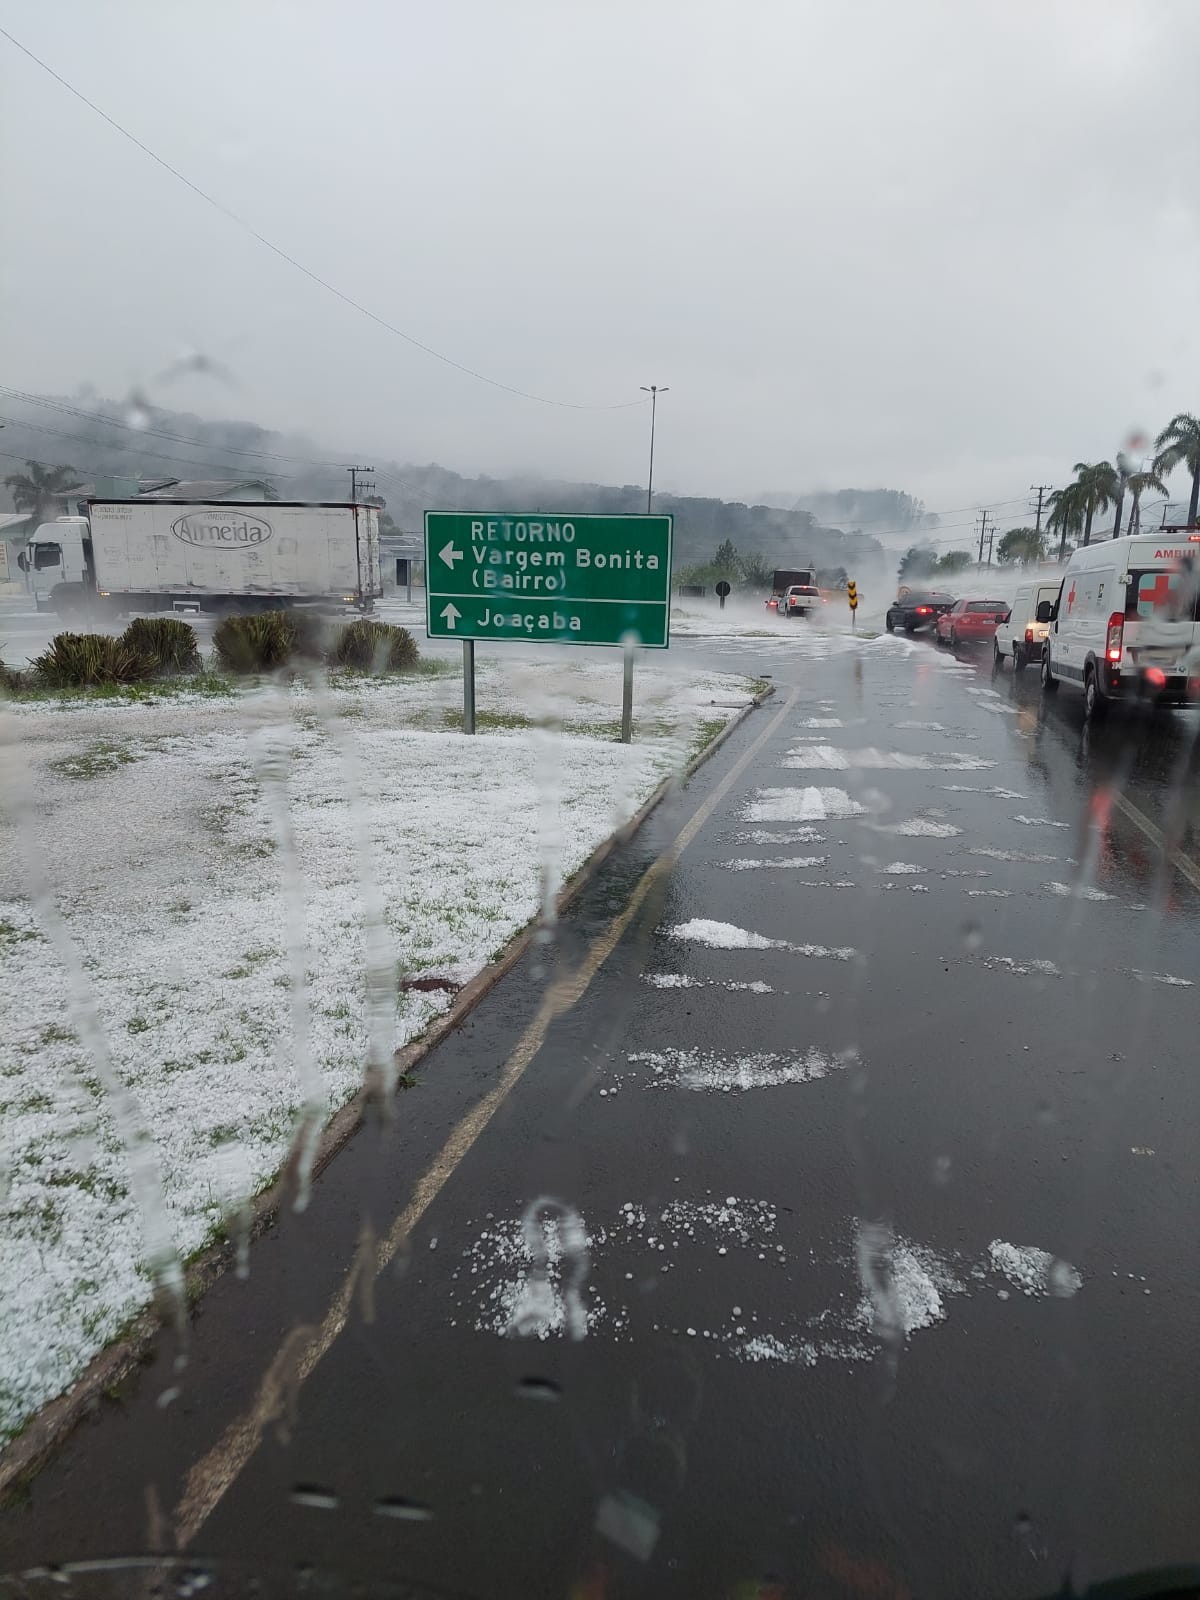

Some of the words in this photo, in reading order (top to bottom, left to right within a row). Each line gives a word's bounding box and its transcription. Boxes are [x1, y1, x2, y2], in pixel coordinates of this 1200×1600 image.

[179, 519, 263, 542] Almeida
[471, 521, 576, 543] RETORNO
[471, 545, 566, 571] Vargem
[575, 548, 660, 570] Bonita
[472, 568, 567, 591] (Bairro)
[476, 608, 581, 632] Joaçaba
